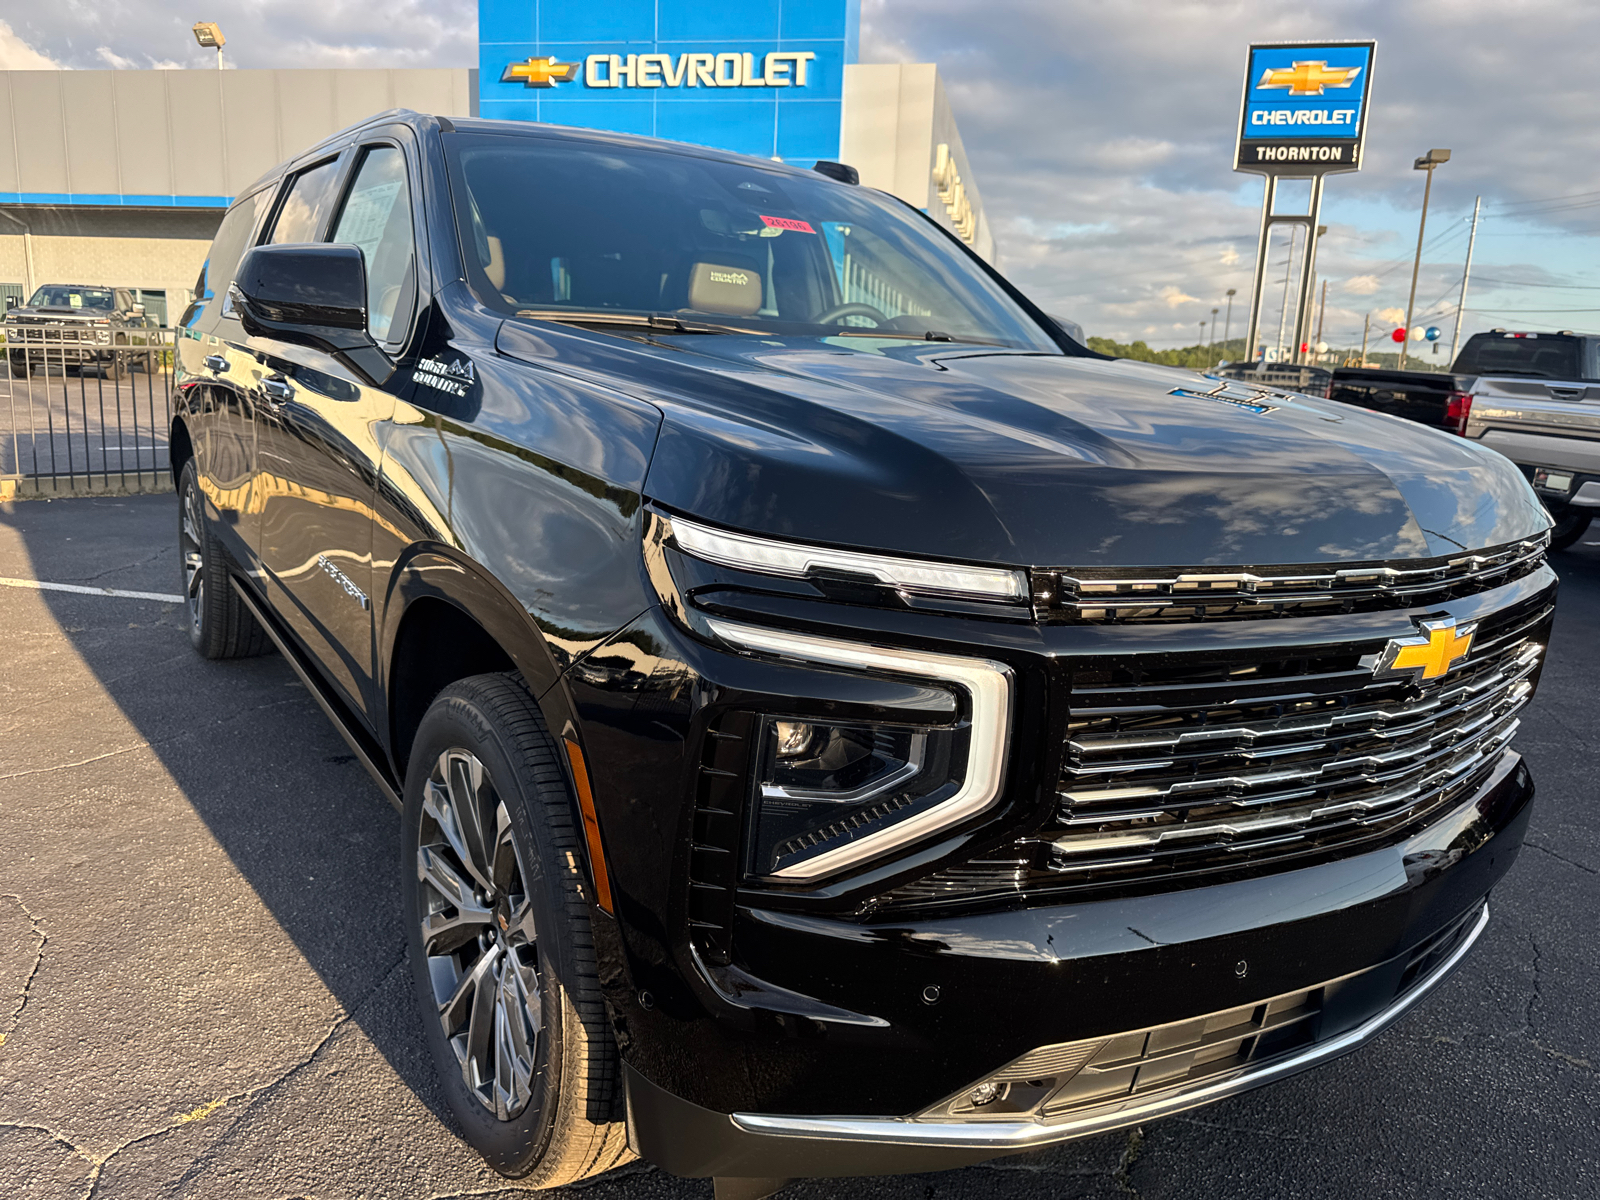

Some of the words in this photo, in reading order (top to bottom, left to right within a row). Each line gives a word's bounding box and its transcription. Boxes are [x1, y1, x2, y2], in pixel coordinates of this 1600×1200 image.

[585, 52, 815, 88] CHEVROLET
[1251, 109, 1356, 126] CHEVROLET
[1256, 146, 1342, 161] THORNTON
[767, 217, 807, 231] 26196
[763, 800, 813, 808] CHEVROLET
